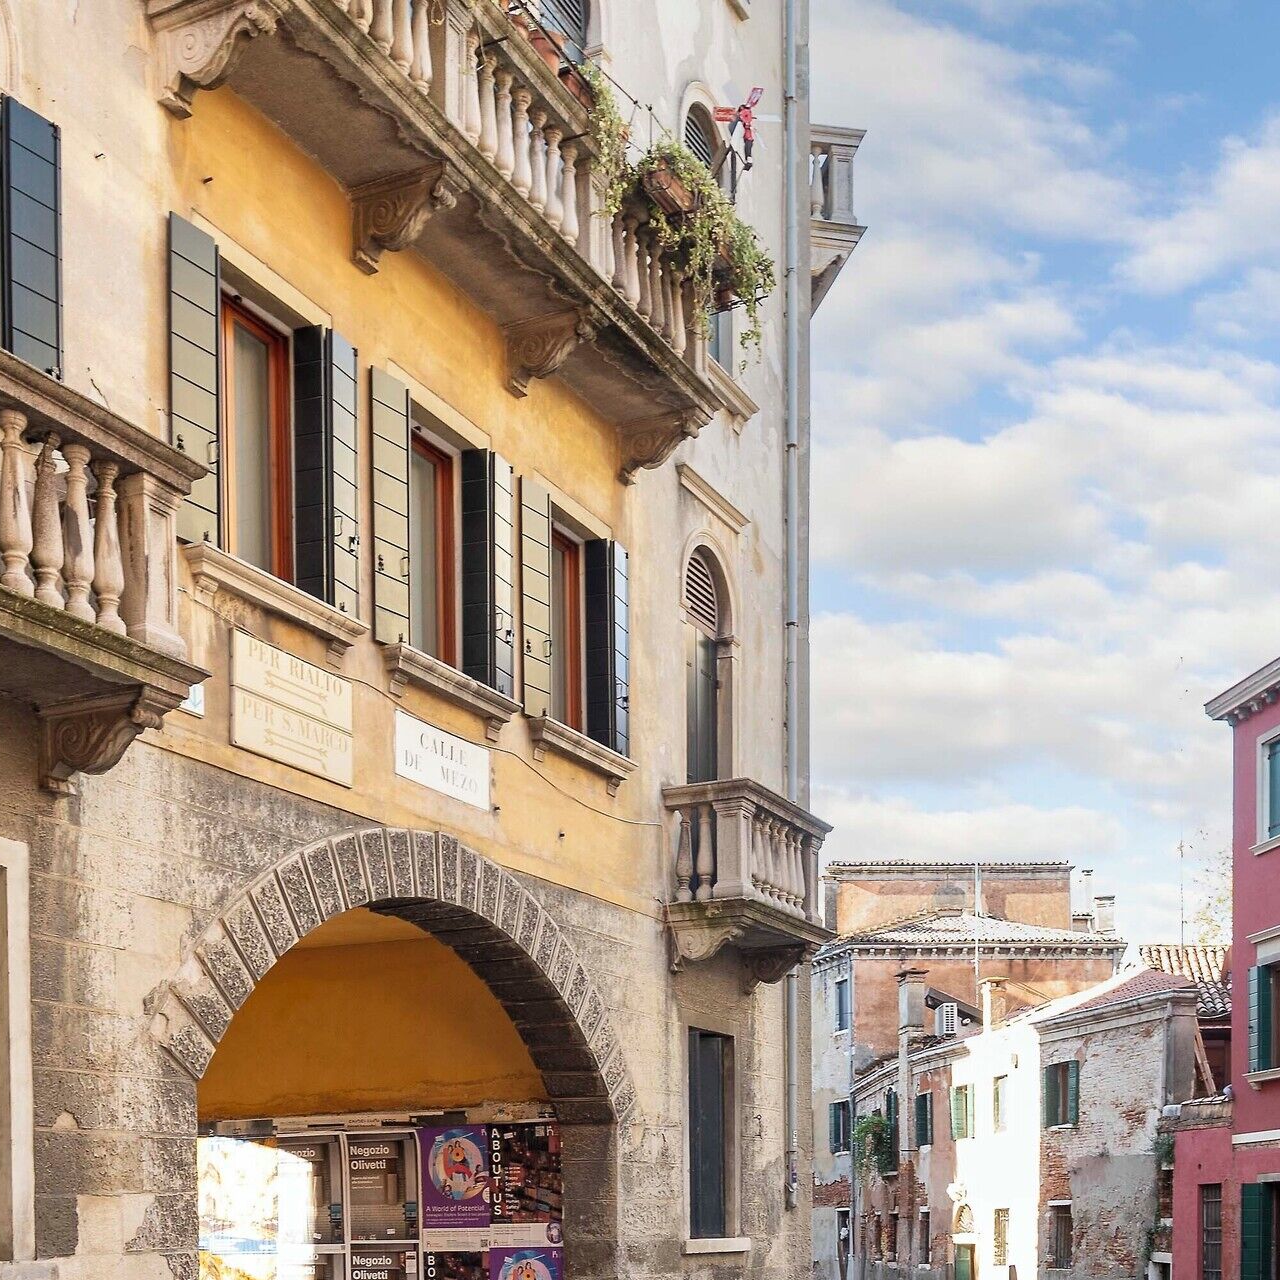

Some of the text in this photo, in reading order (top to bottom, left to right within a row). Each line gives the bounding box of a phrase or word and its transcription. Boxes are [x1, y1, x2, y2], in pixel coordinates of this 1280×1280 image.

[248, 639, 342, 697] PER RIALTO
[242, 693, 274, 725] PER
[420, 732, 468, 767] CALLE
[405, 749, 478, 793] DE MEZO
[349, 1145, 390, 1156] Negozio
[350, 1159, 386, 1170] Olivetti
[491, 1128, 502, 1215] ABOUT US
[352, 1255, 392, 1267] Negozio
[352, 1270, 388, 1280] Olivetti
